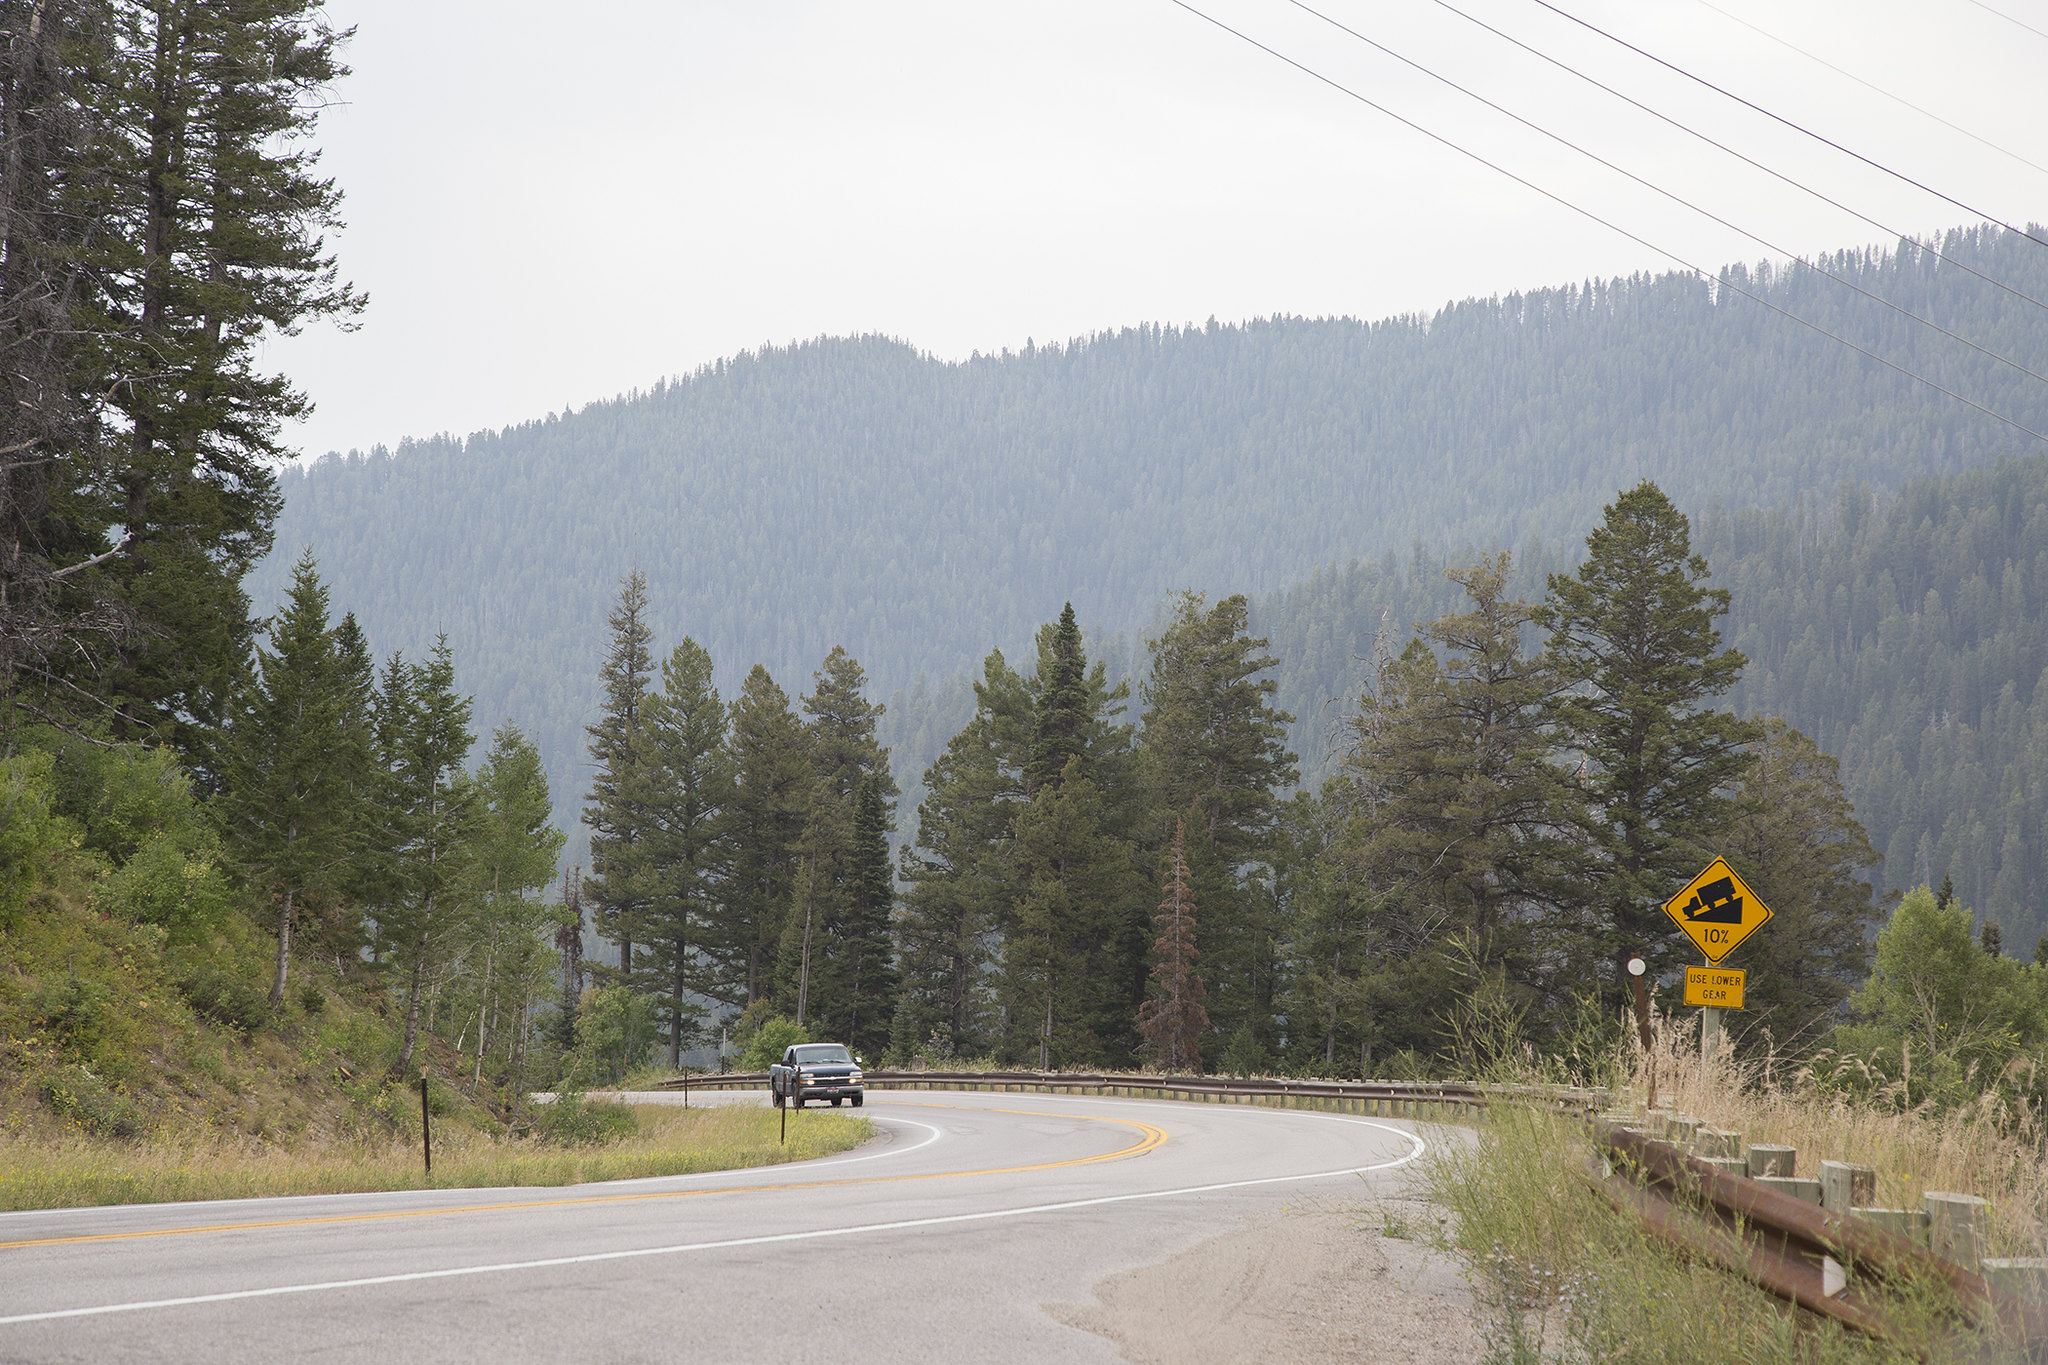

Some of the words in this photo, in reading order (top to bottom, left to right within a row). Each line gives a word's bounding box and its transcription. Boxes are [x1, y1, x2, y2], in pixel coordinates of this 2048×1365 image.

[1704, 928, 1729, 944] 10%
[1690, 974, 1707, 984] USE
[1712, 975, 1741, 986] LOWER
[1702, 989, 1727, 1000] GEAR
